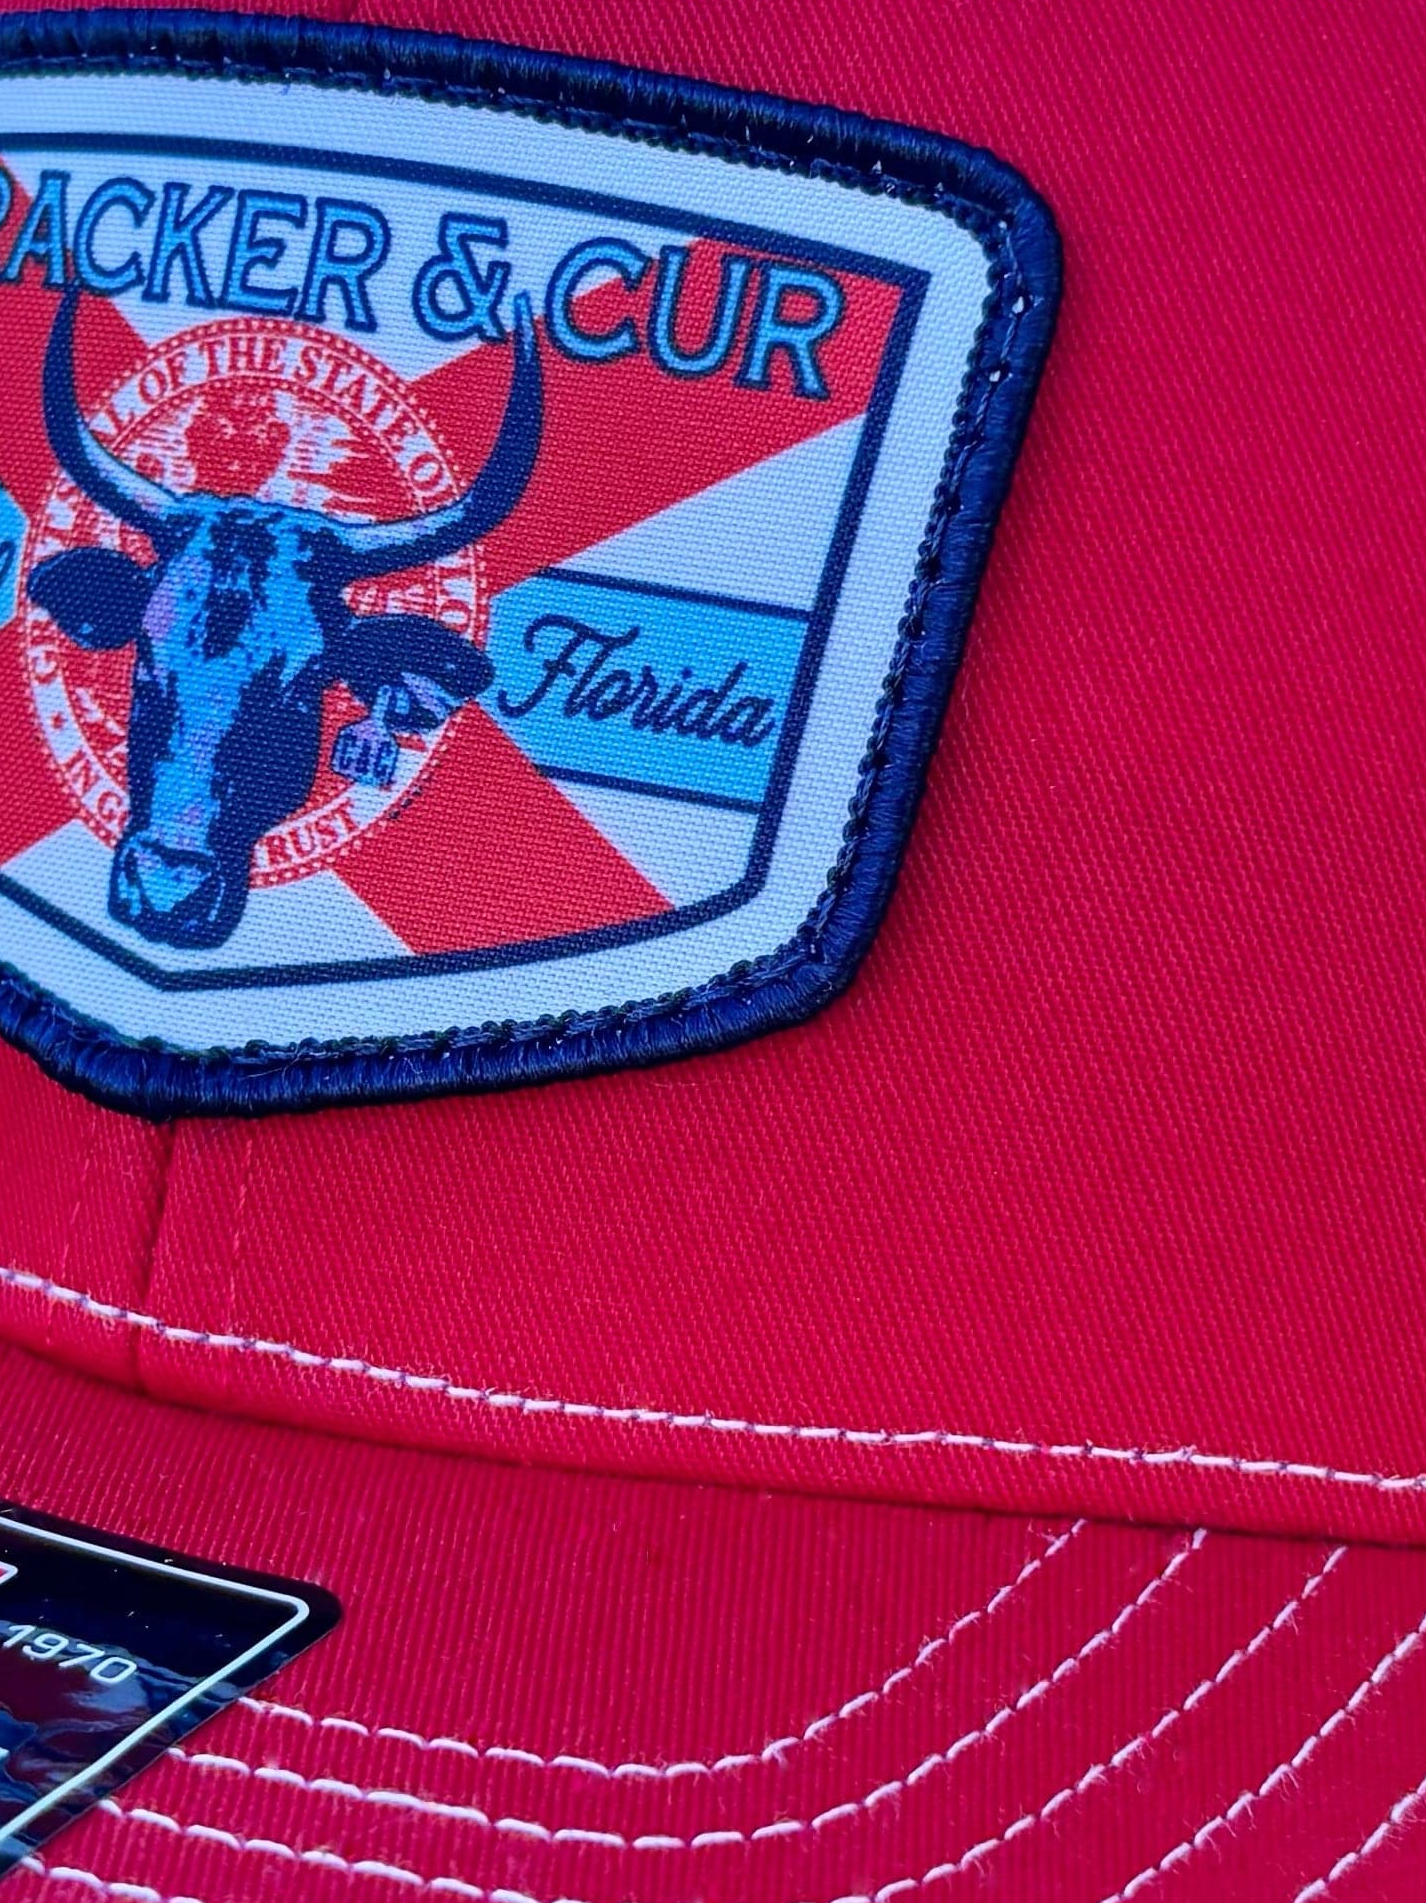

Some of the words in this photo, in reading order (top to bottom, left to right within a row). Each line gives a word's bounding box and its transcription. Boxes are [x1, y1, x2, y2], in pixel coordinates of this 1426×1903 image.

[412, 211, 511, 343] &
[546, 236, 846, 401] CUR
[138, 351, 186, 401] OF
[199, 336, 286, 377] THE
[294, 345, 415, 455] STATE
[497, 613, 774, 747] Florida
[253, 797, 357, 865] RUST
[2, 1624, 138, 1685] 1970
